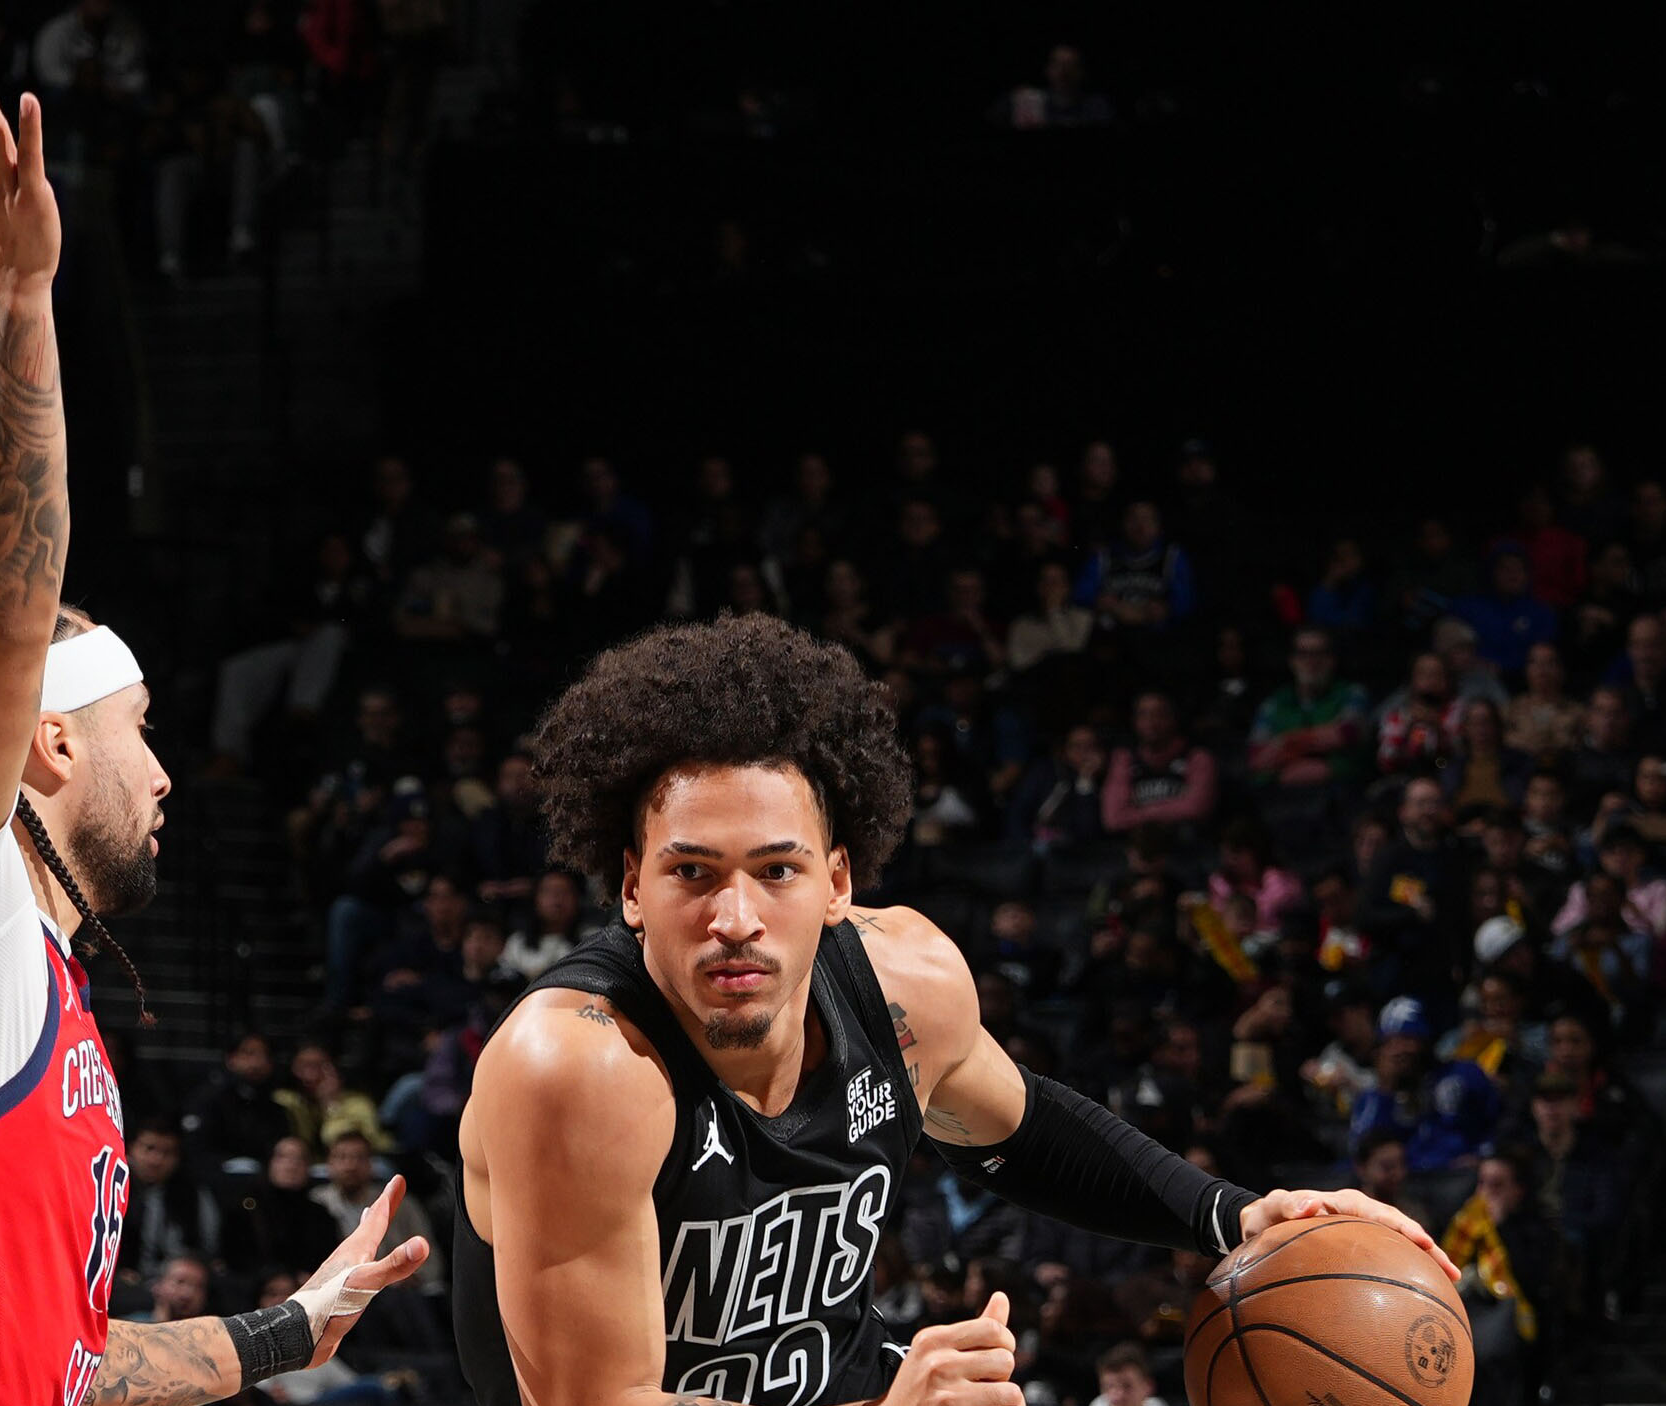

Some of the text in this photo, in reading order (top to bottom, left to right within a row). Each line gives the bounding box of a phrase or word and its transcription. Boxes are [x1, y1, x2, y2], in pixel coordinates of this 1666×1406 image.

[847, 1069, 872, 1104] GET
[848, 1082, 892, 1122] YOUR
[848, 1100, 896, 1144] GUIDE
[85, 1145, 129, 1313] 15
[663, 1164, 891, 1347] NETS
